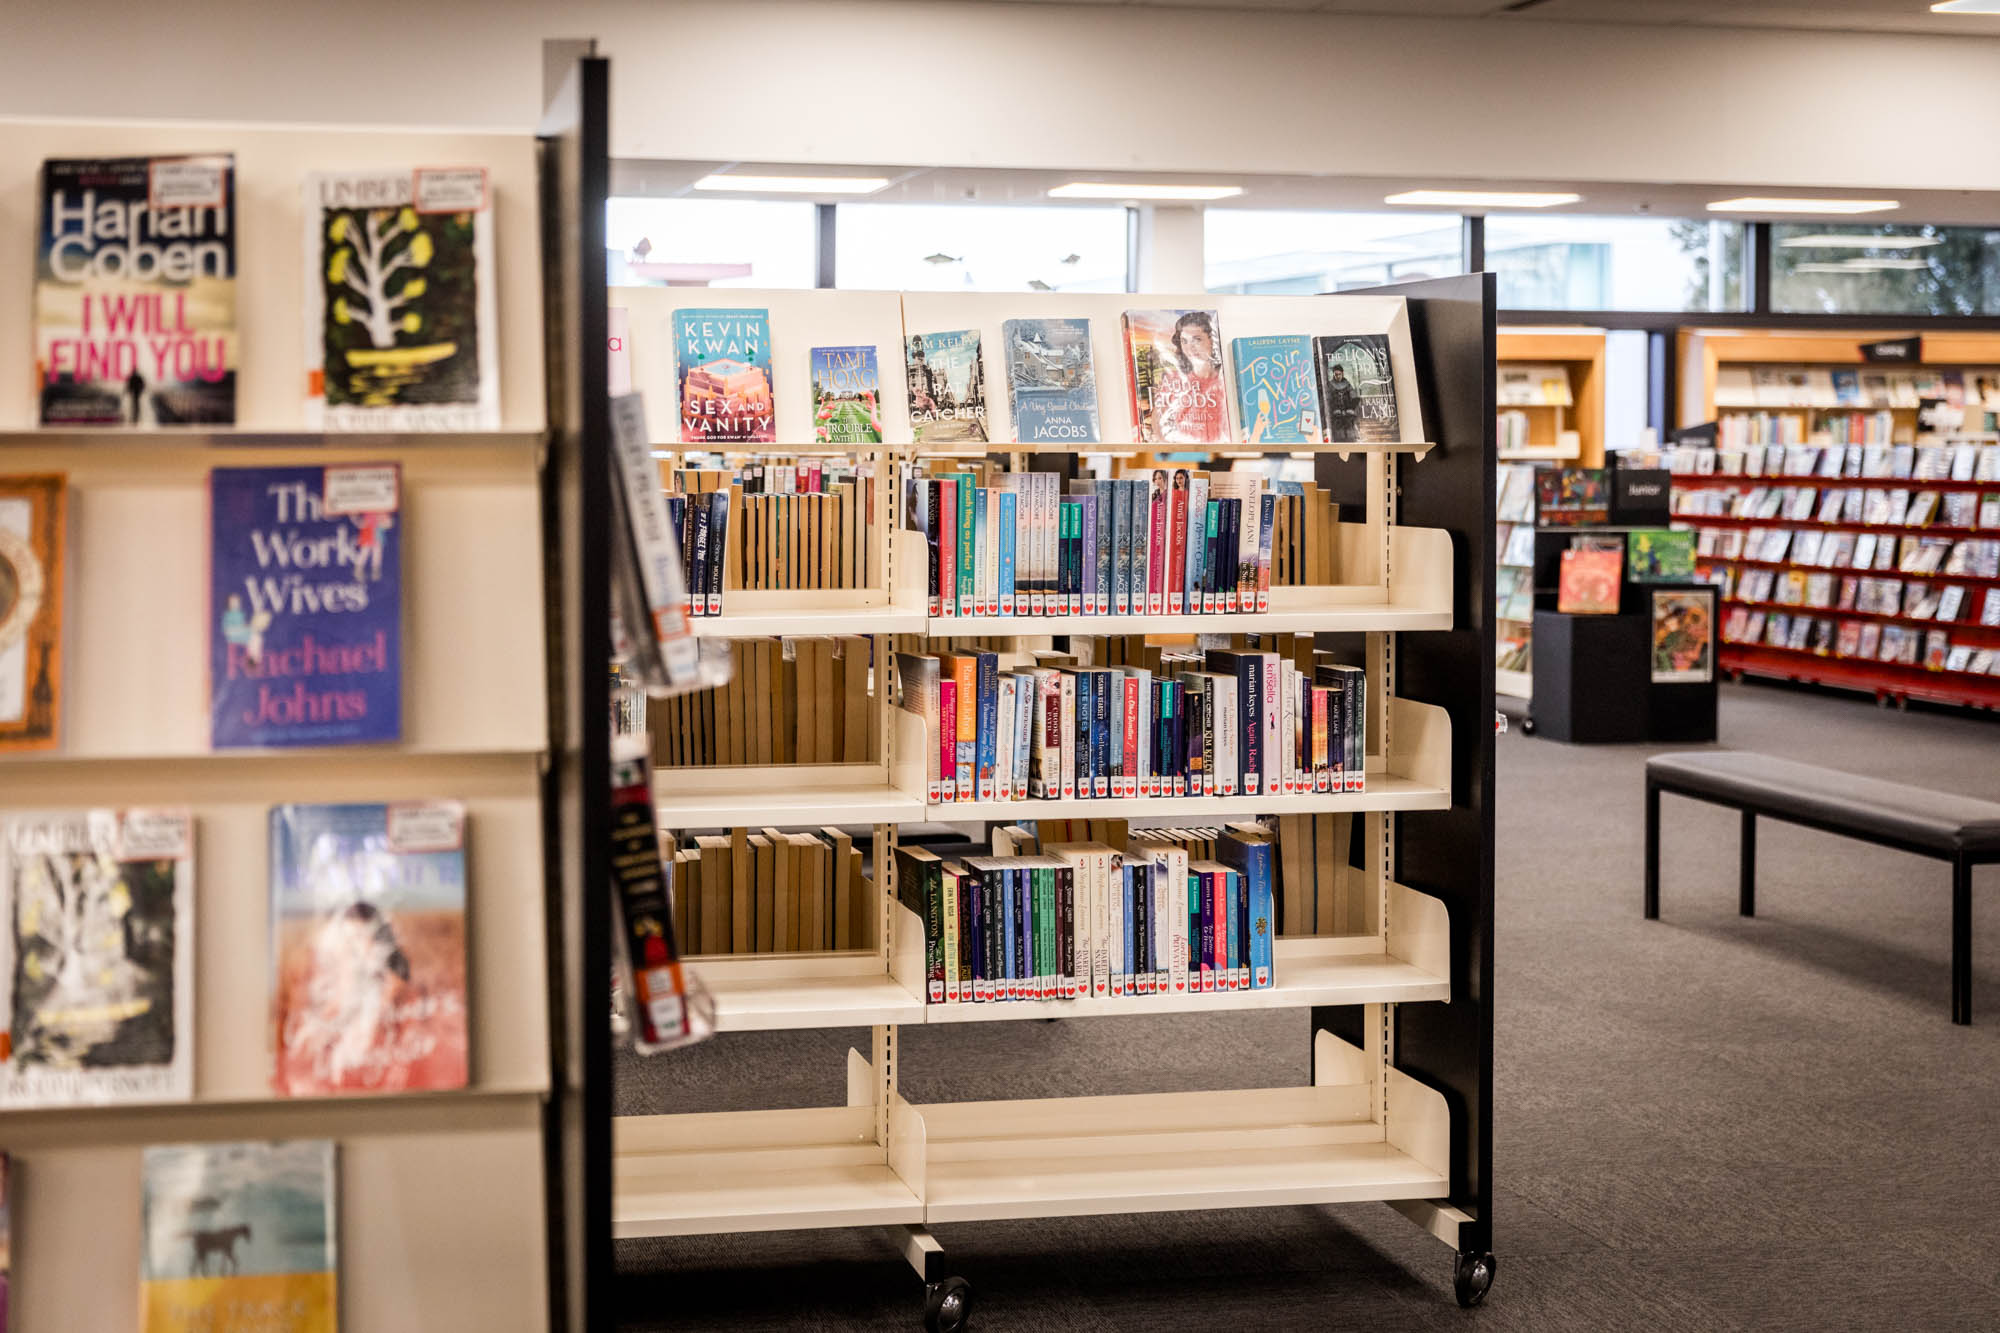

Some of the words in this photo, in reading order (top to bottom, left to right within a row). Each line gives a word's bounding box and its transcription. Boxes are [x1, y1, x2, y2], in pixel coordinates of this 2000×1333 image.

[49, 233, 227, 283] Coben
[82, 293, 92, 335] I
[102, 292, 195, 336] WILL
[685, 322, 760, 337] KEVIN
[688, 339, 759, 354] KWAN
[910, 338, 934, 351] KIM
[938, 335, 974, 349] KELLY
[50, 340, 135, 383] FIND
[149, 338, 226, 382] YOU
[822, 352, 866, 368] TAMI
[928, 357, 961, 370] THE
[1325, 352, 1343, 362] THE
[1344, 347, 1387, 361] LION'S
[817, 369, 875, 388] HOAG
[1159, 375, 1201, 392] Anna
[932, 383, 963, 396] RAT
[1148, 387, 1217, 411] Jacobs
[690, 400, 732, 415] SEX
[738, 403, 765, 411] AND
[910, 406, 985, 423] CATCHER
[1361, 404, 1397, 419] LANE
[684, 416, 771, 432] VANITY
[824, 423, 872, 433] TROUBLE
[1044, 417, 1073, 425] ANNA
[1033, 425, 1088, 439] JACOBS
[966, 477, 972, 488] no
[965, 490, 973, 507] such
[1248, 479, 1257, 523] PENELOPE
[963, 509, 973, 529] thing
[1156, 501, 1164, 521] Anna
[1176, 500, 1185, 520] Anna
[698, 523, 708, 548] FORGET
[1155, 522, 1163, 546] Jacobs
[1175, 521, 1184, 546] Jacobs
[964, 542, 973, 570] perfect
[712, 565, 720, 583] MOLLY
[245, 574, 370, 615] Wives
[227, 630, 387, 681] Rachael
[963, 665, 973, 704] Rachael
[983, 664, 992, 698] Johnson
[1248, 664, 1257, 693] marian
[1266, 663, 1276, 704] kinsella
[244, 682, 367, 727] Johns
[1246, 694, 1256, 718] keyes
[962, 705, 973, 736] Johns
[1021, 706, 1029, 743] DEFENDER
[1205, 730, 1213, 747] KIM
[1098, 733, 1107, 776] bellewether
[1204, 748, 1213, 773] KELLY
[930, 893, 939, 937] LANGTON
[1204, 898, 1212, 917] Layne
[928, 940, 936, 979] Preserving
[935, 958, 943, 969] Art
